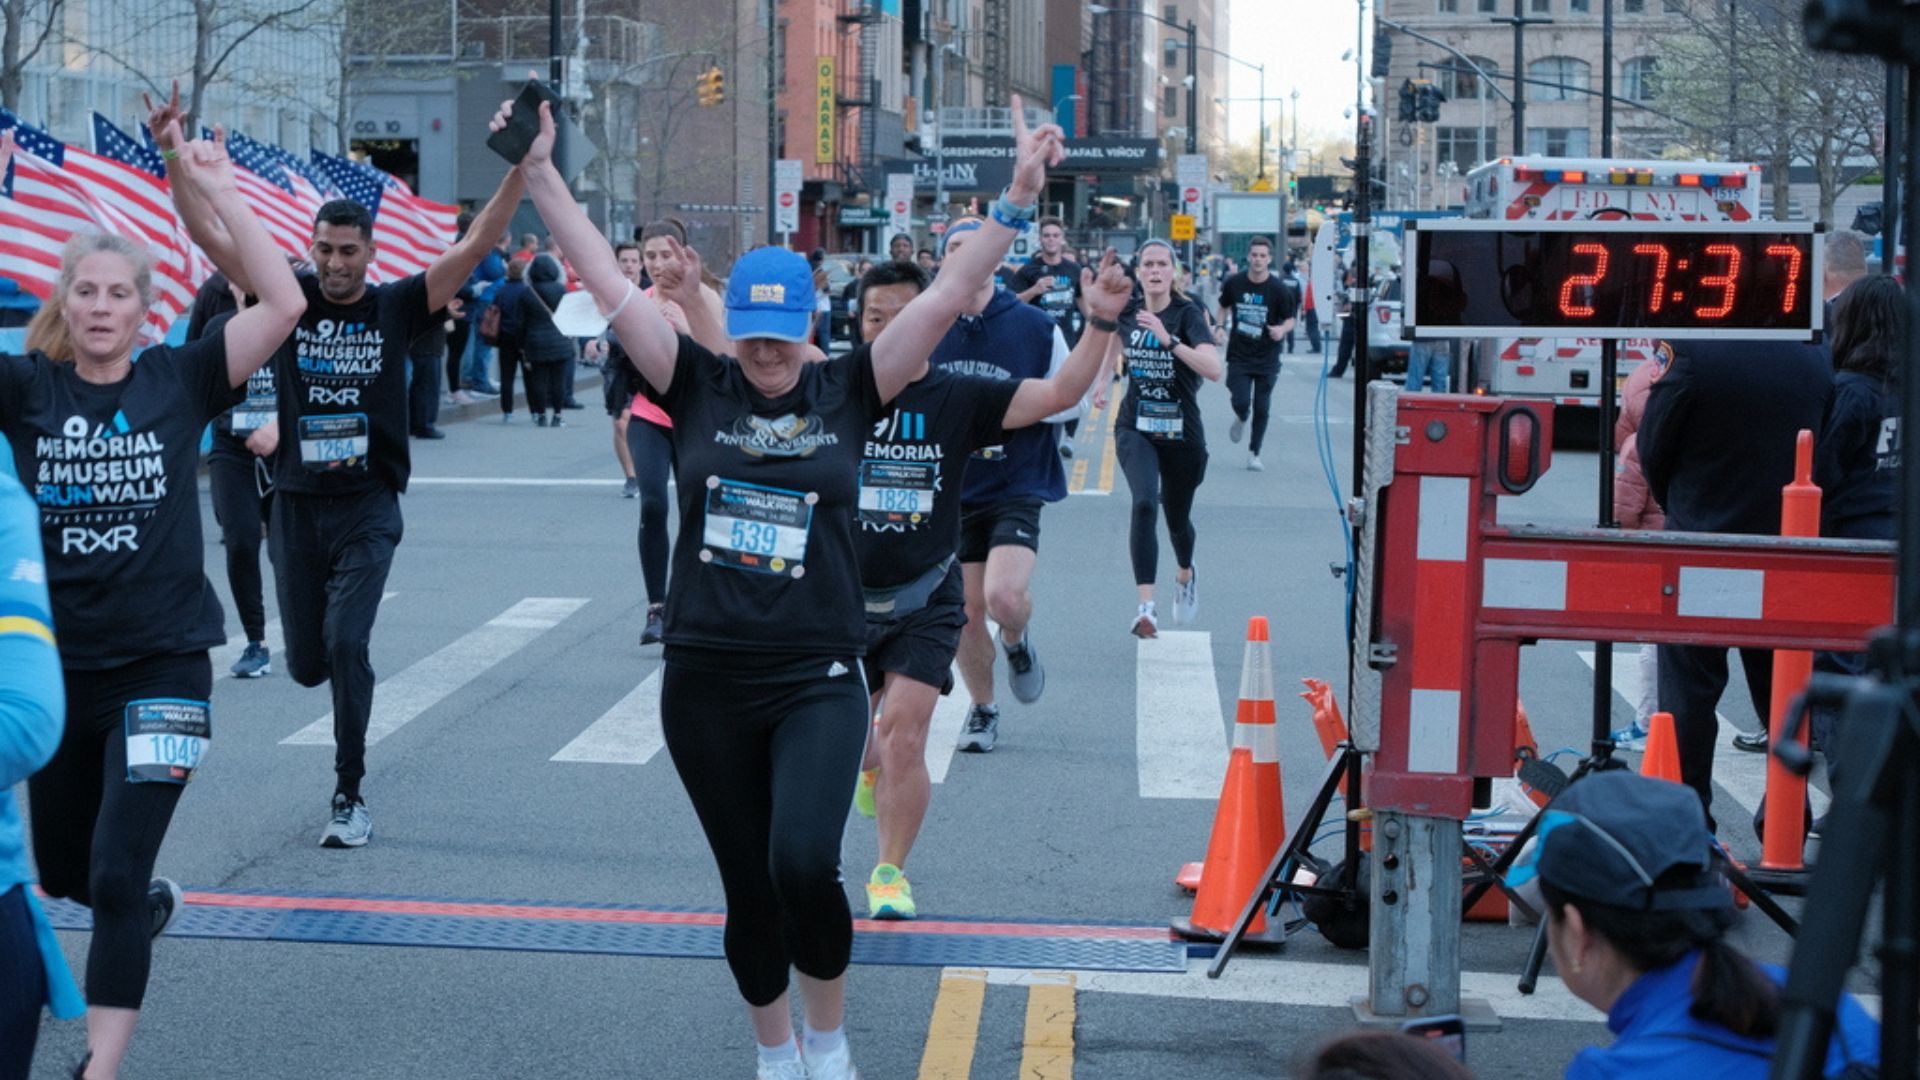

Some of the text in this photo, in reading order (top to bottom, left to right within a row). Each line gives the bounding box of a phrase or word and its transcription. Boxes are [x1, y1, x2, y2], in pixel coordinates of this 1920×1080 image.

[385, 120, 400, 133] 10
[942, 147, 1006, 157] GREENWICH
[1064, 147, 1104, 158] RAFAEL
[1106, 145, 1147, 158] VIÑOLY
[1559, 243, 1802, 317] 27:37
[1126, 349, 1174, 360] EMORIAL
[309, 385, 360, 405] RXR
[36, 431, 164, 460] MEMORIAL
[314, 439, 356, 461] 1264
[863, 441, 944, 460] EMORIAL
[875, 488, 919, 512] 1826
[62, 524, 139, 554] RXR
[730, 519, 778, 554] 539
[150, 735, 200, 768] 1049
